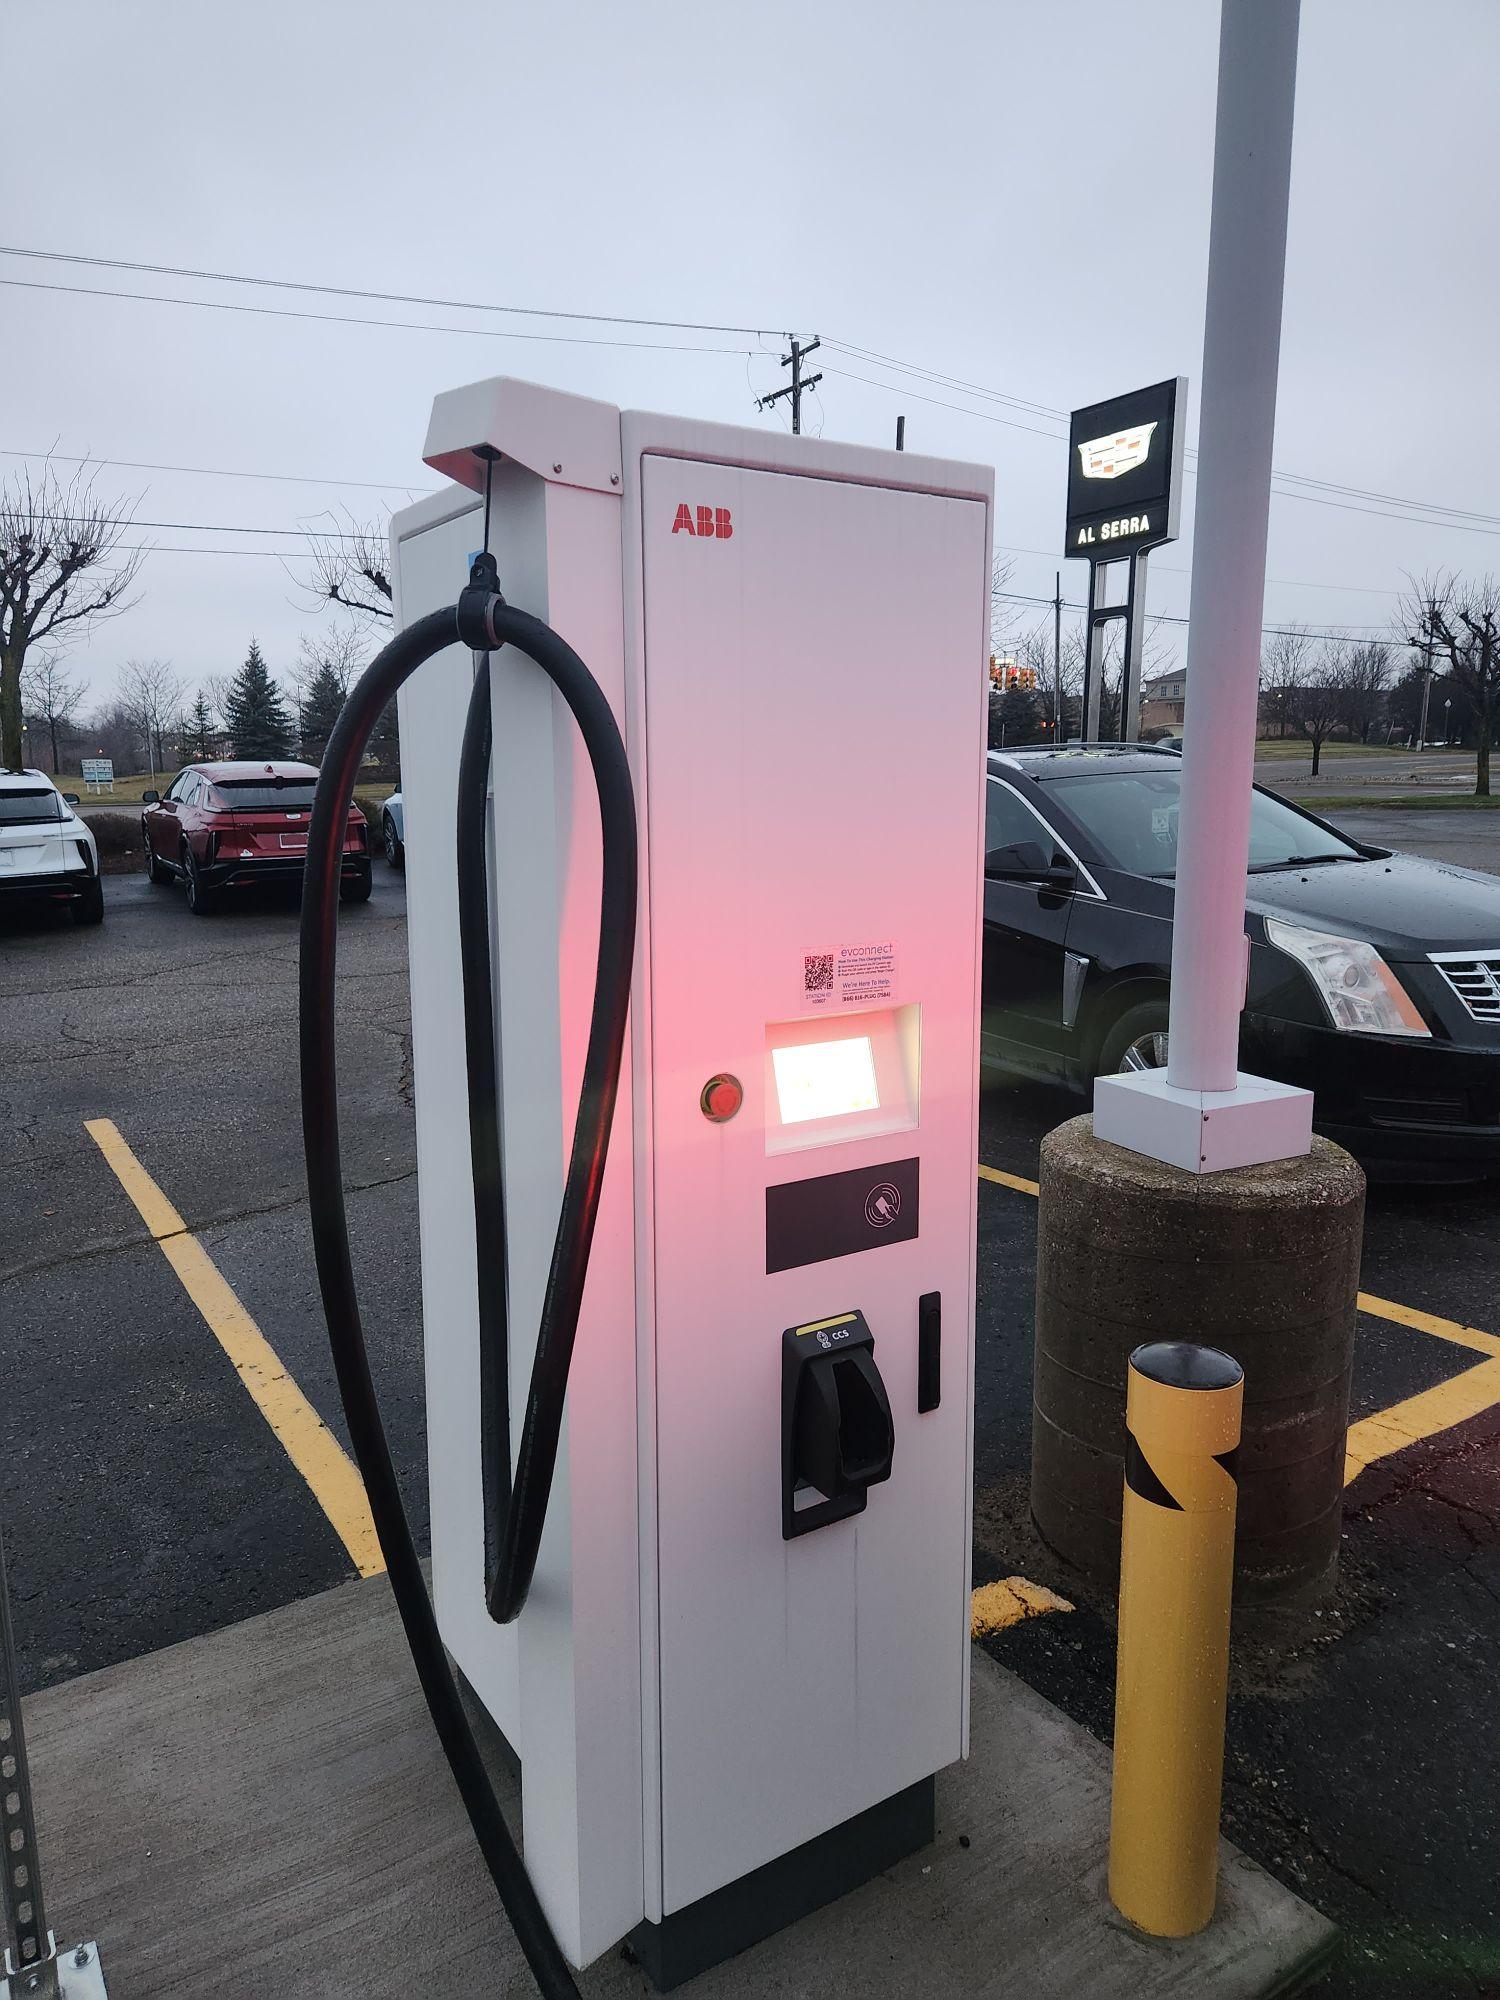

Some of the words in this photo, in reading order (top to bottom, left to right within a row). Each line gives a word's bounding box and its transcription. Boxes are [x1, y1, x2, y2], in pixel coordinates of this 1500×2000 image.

[671, 503, 733, 539] ABB
[1077, 526, 1095, 545] AL
[1101, 514, 1150, 540] SERRA
[841, 943, 893, 957] evconnect
[832, 1329, 849, 1341] CCS
